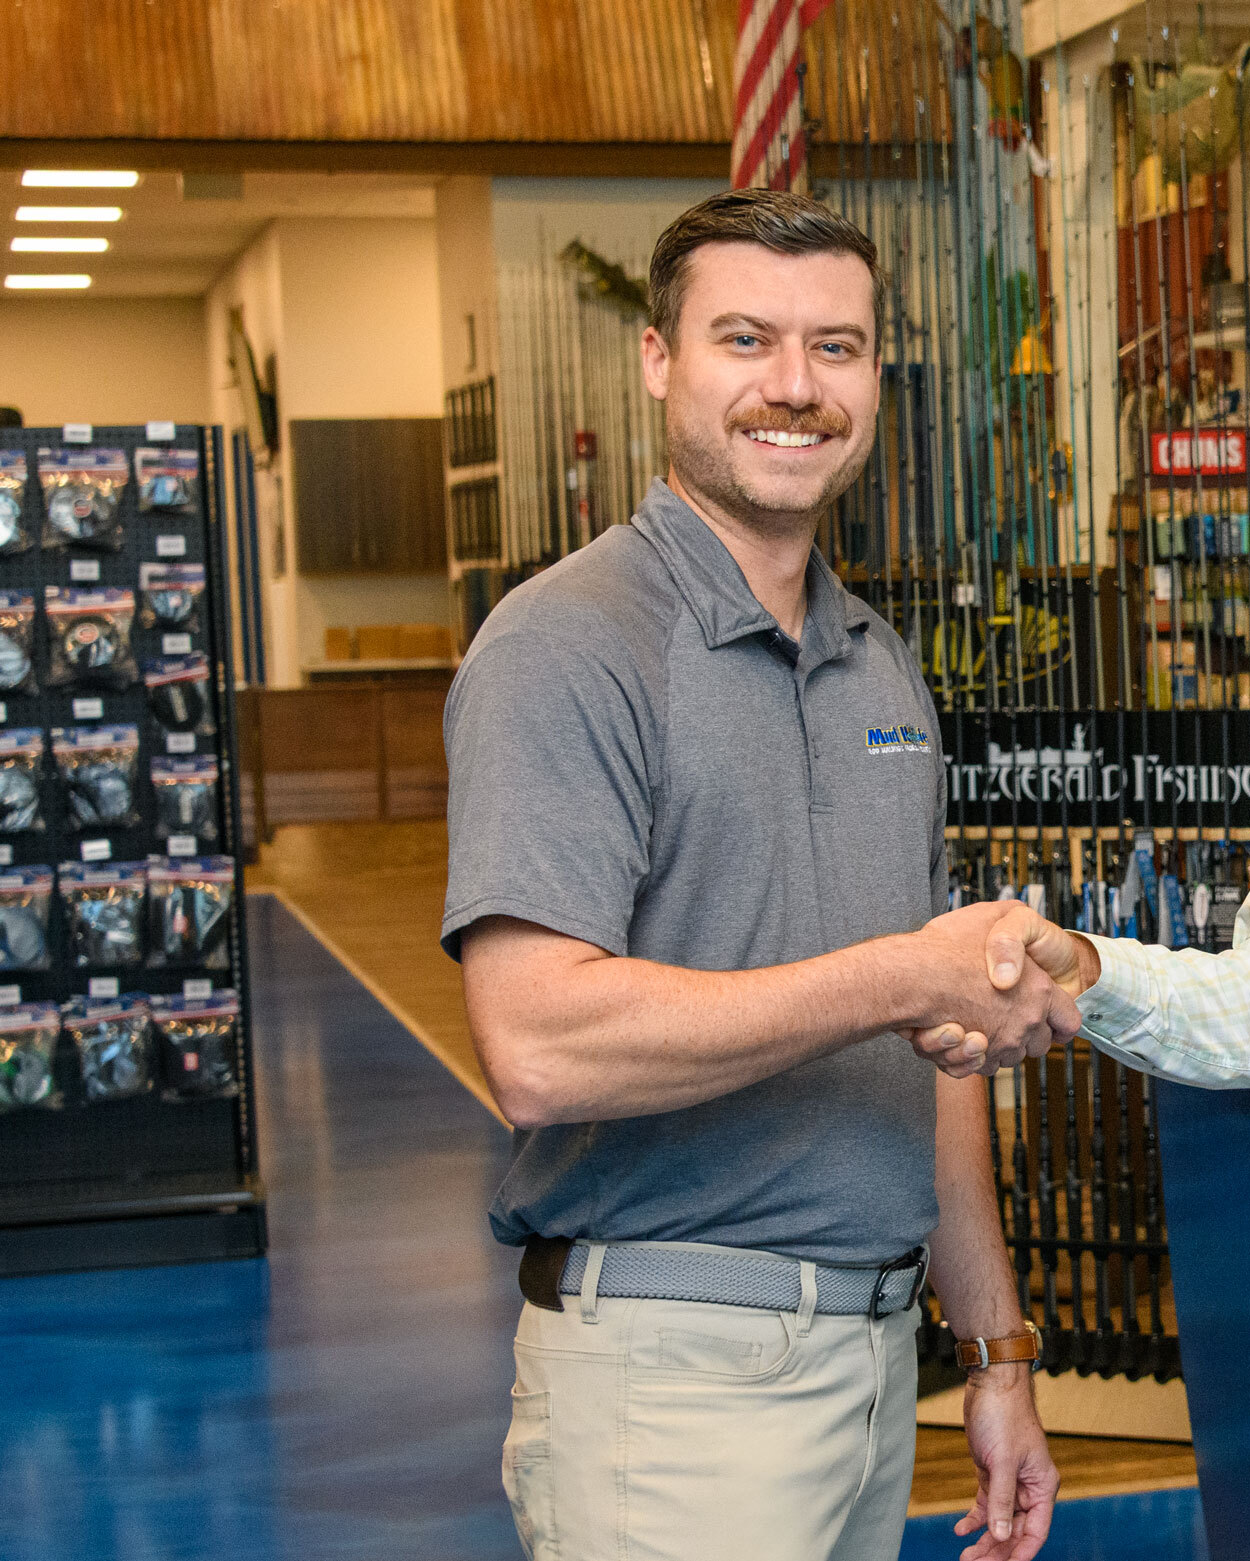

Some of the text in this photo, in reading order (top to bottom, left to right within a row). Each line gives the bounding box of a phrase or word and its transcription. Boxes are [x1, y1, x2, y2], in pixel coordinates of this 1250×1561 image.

[1158, 436, 1242, 469] CHUMS
[865, 727, 900, 747] Mud
[943, 754, 1129, 803] ITZGERALD
